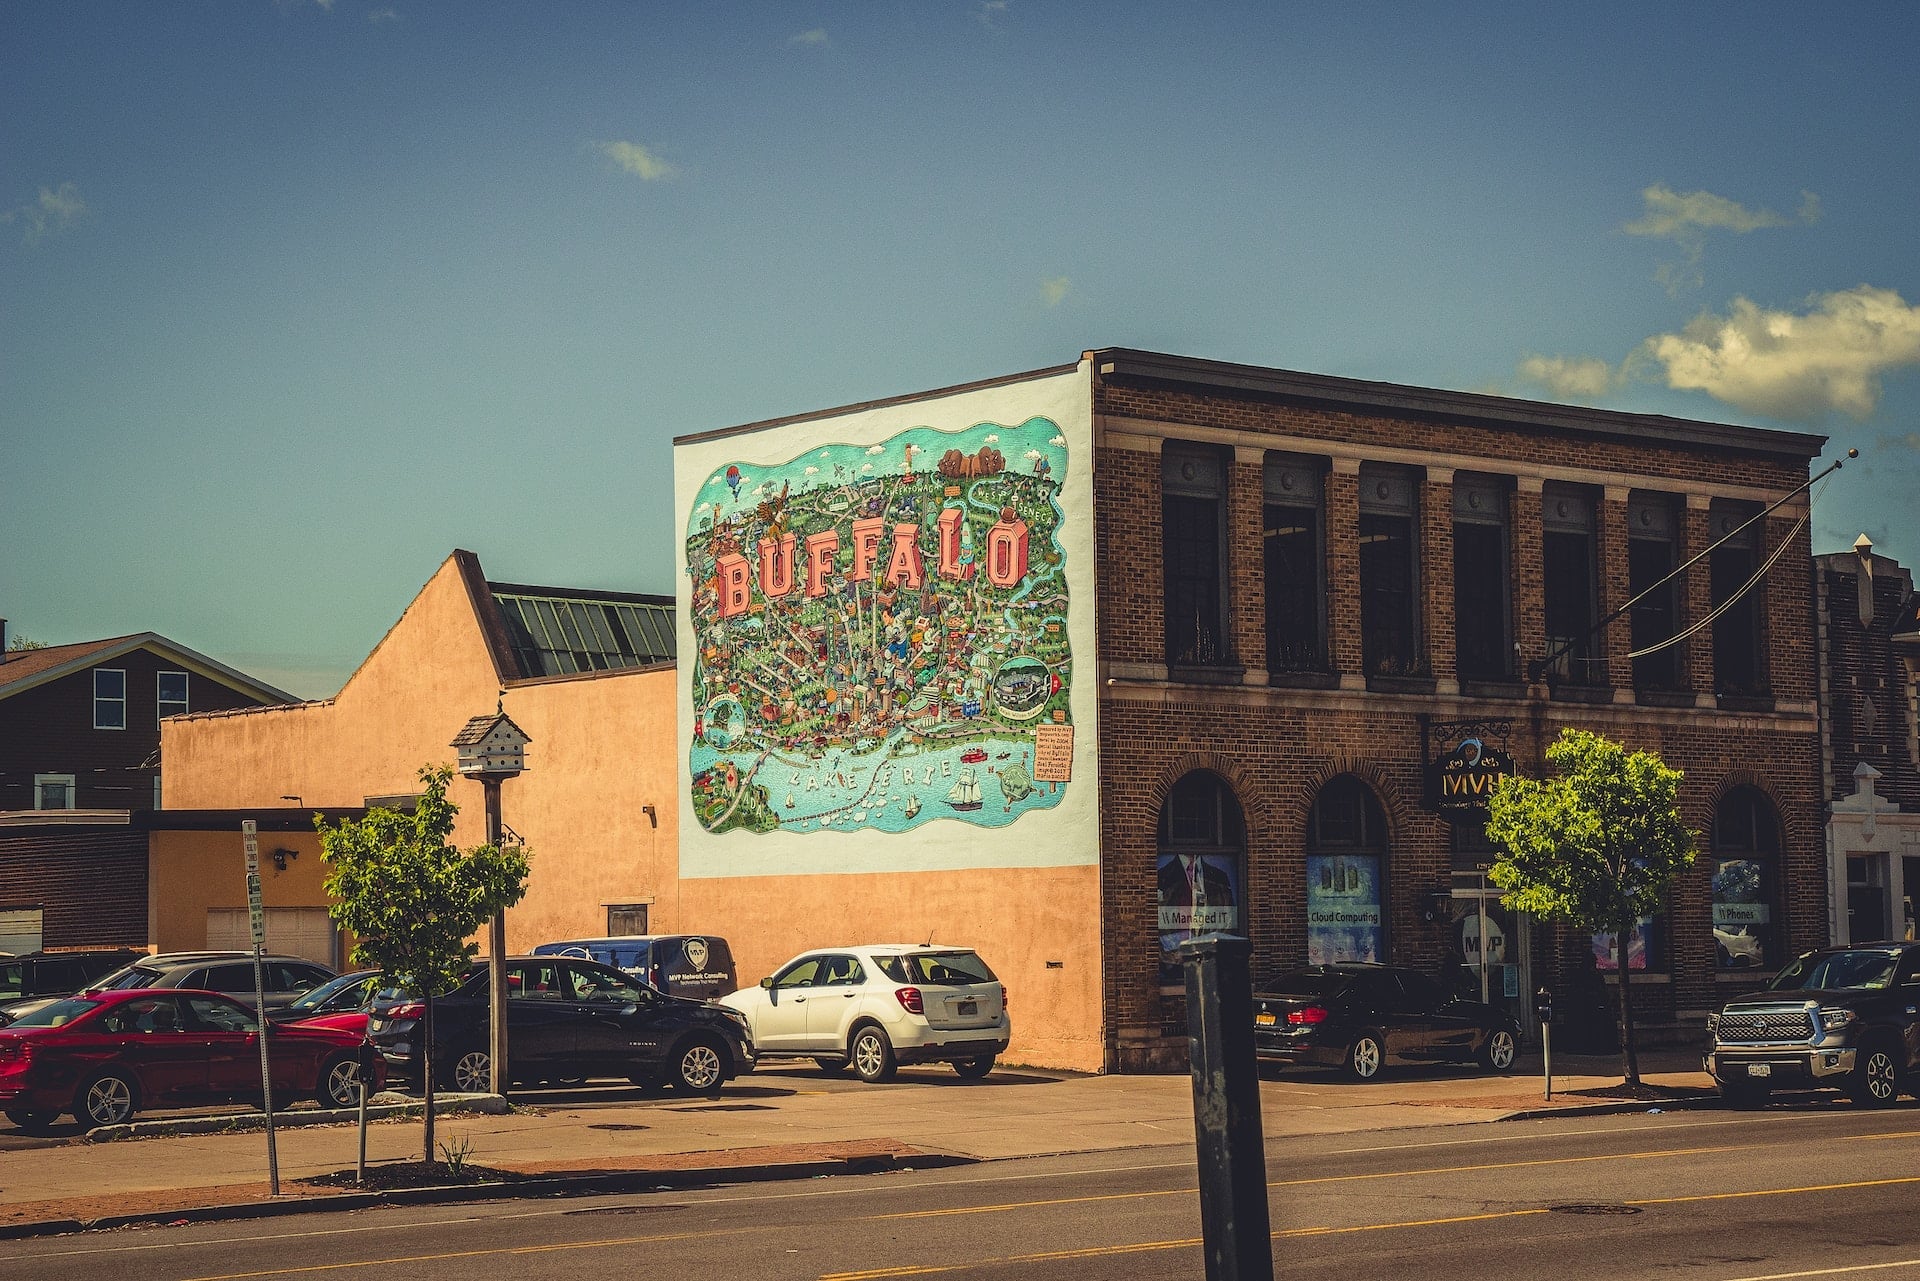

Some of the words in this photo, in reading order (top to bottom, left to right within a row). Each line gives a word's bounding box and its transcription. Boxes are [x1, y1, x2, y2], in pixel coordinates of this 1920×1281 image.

[885, 484, 939, 497] CHEEKTOWAGA
[977, 490, 1003, 502] WEST
[1017, 502, 1053, 526] SENECA
[715, 508, 1029, 619] BUFFALO
[788, 770, 858, 791] LAKE
[880, 760, 954, 787] ERIE
[712, 786, 762, 818] CANADA
[1172, 911, 1216, 925] Managed
[1217, 912, 1227, 923] IT
[1311, 911, 1334, 923] Cloud
[1335, 911, 1378, 926] Computing
[1726, 909, 1754, 920] Phones
